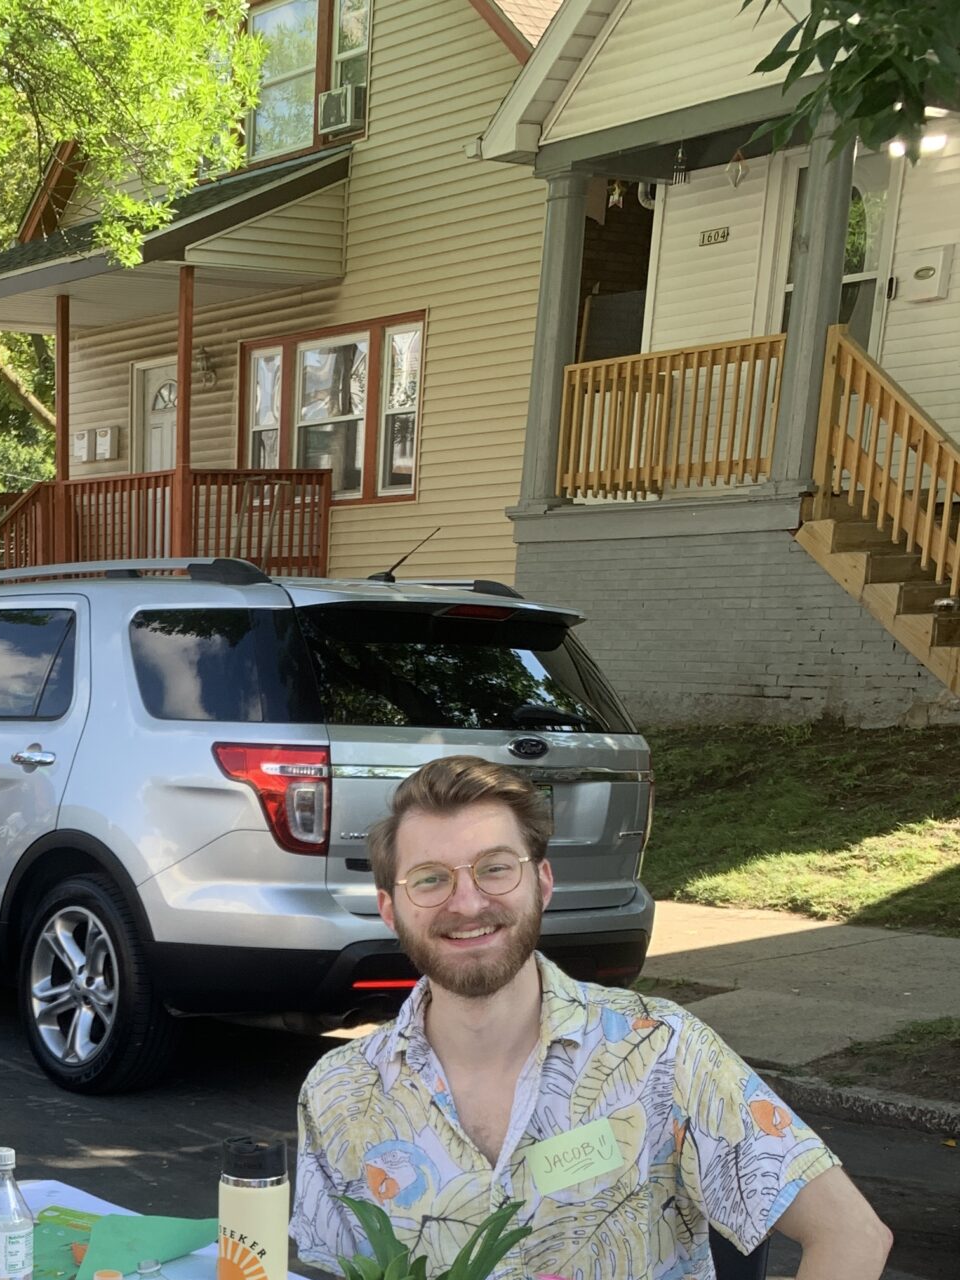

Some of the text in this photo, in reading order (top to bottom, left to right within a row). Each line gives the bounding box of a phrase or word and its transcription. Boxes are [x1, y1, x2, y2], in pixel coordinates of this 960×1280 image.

[701, 230, 726, 245] 1604
[543, 1142, 596, 1174] JACOB
[220, 1225, 267, 1260] SEEKER
